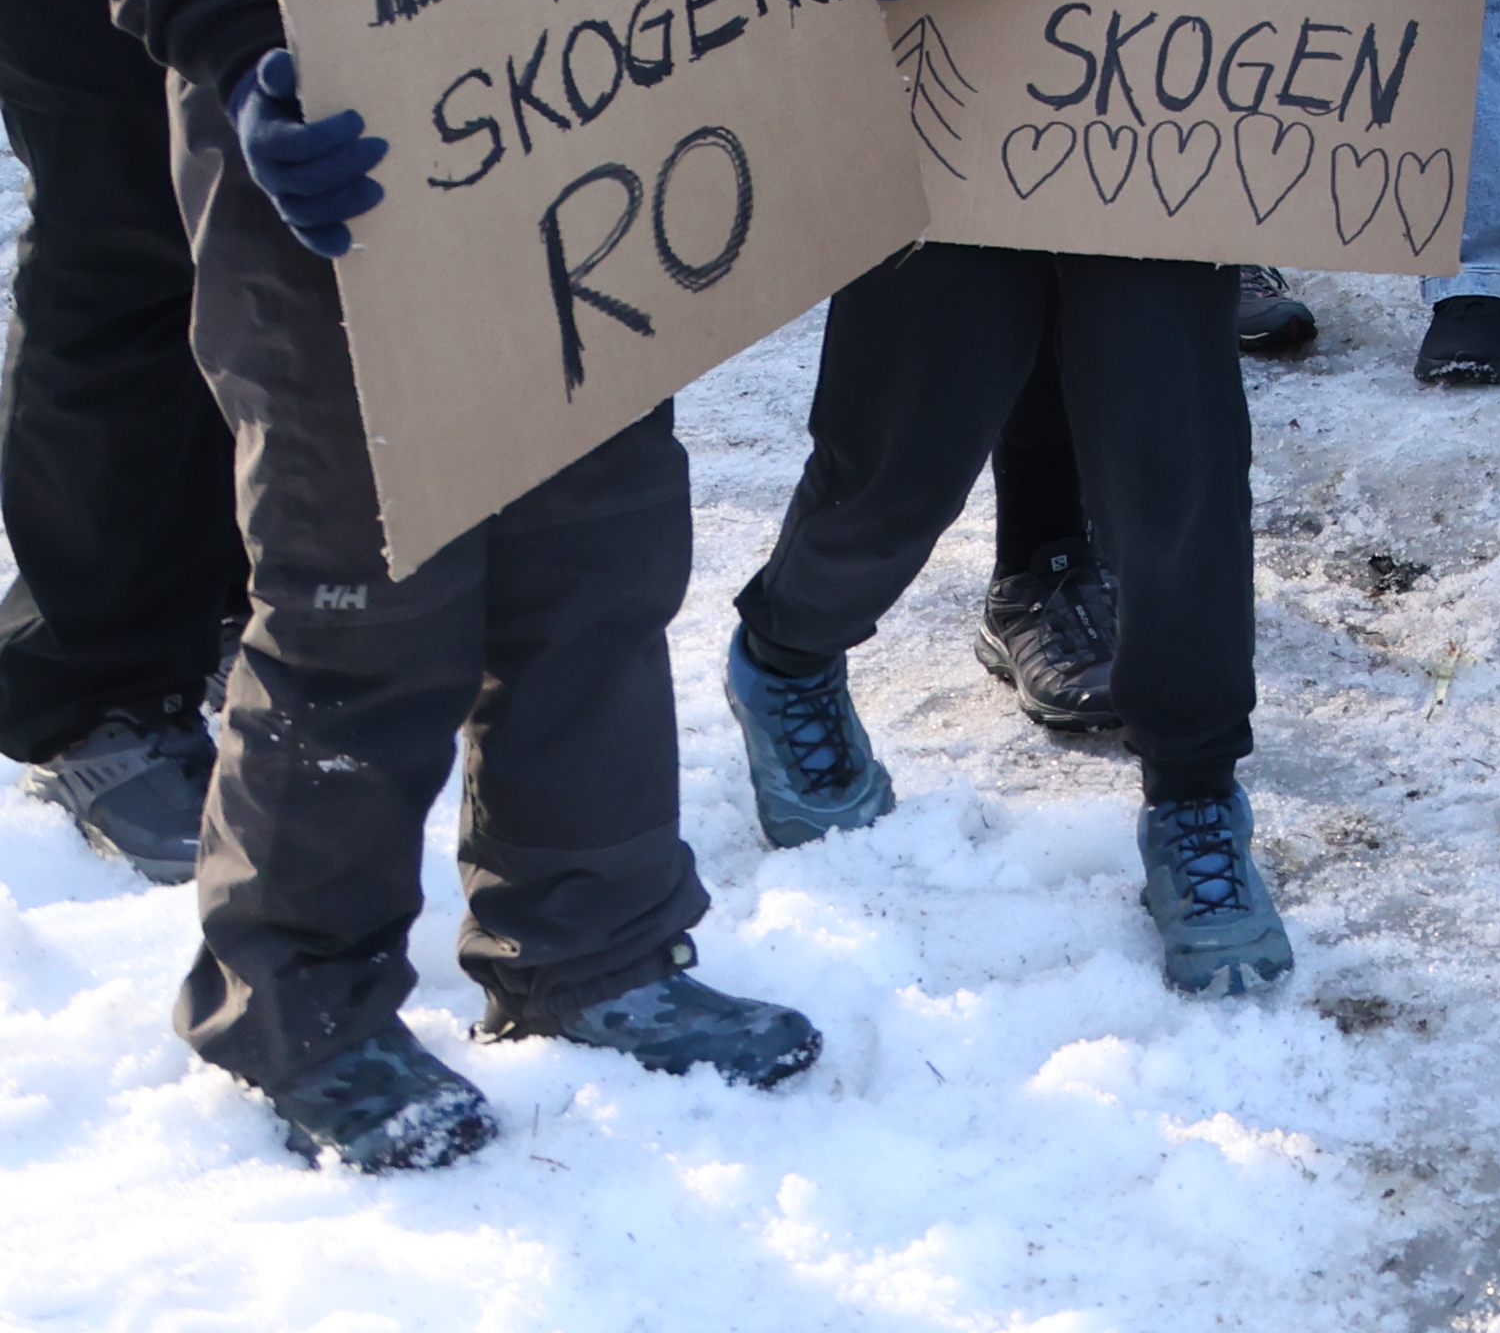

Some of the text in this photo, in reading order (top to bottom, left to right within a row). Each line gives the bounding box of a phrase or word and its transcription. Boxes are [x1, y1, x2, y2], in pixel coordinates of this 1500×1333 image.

[1026, 1, 1420, 132] SKOGEN
[537, 123, 756, 404] RO
[314, 583, 368, 610] HH
